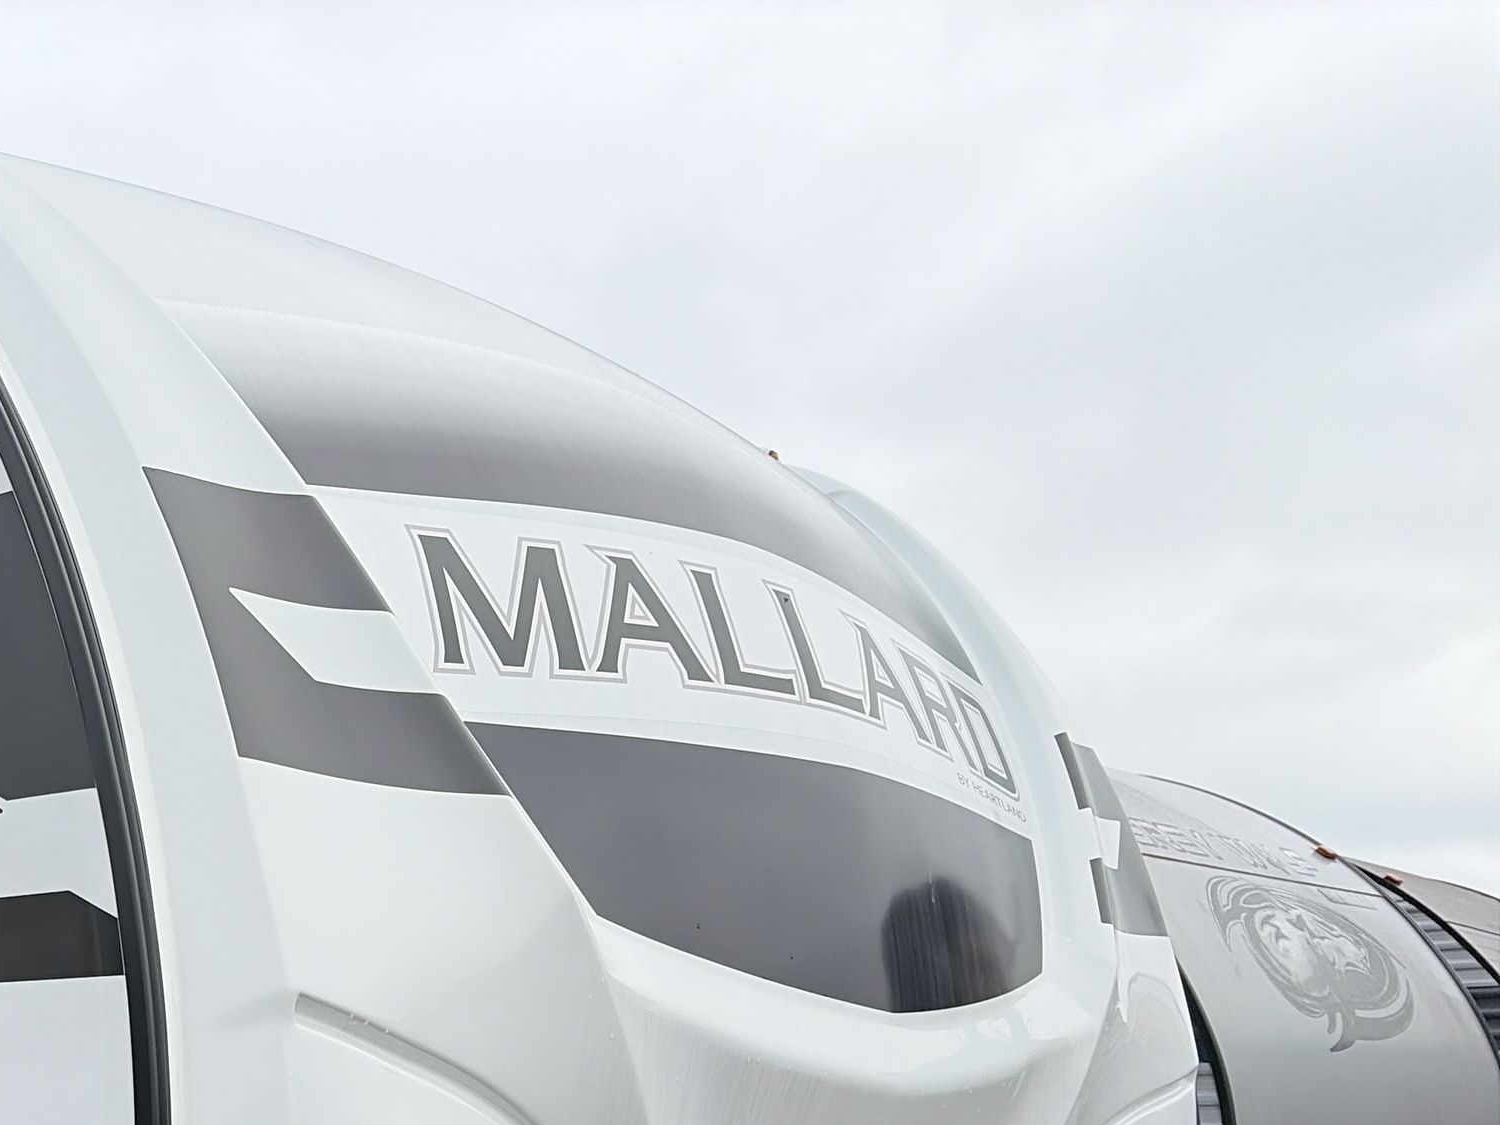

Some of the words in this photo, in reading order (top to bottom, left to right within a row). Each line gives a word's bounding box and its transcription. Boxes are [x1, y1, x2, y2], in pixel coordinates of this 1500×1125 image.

[405, 524, 1020, 800] MALLARD
[956, 772, 970, 788] BY
[972, 781, 1027, 822] HEARTLAND
